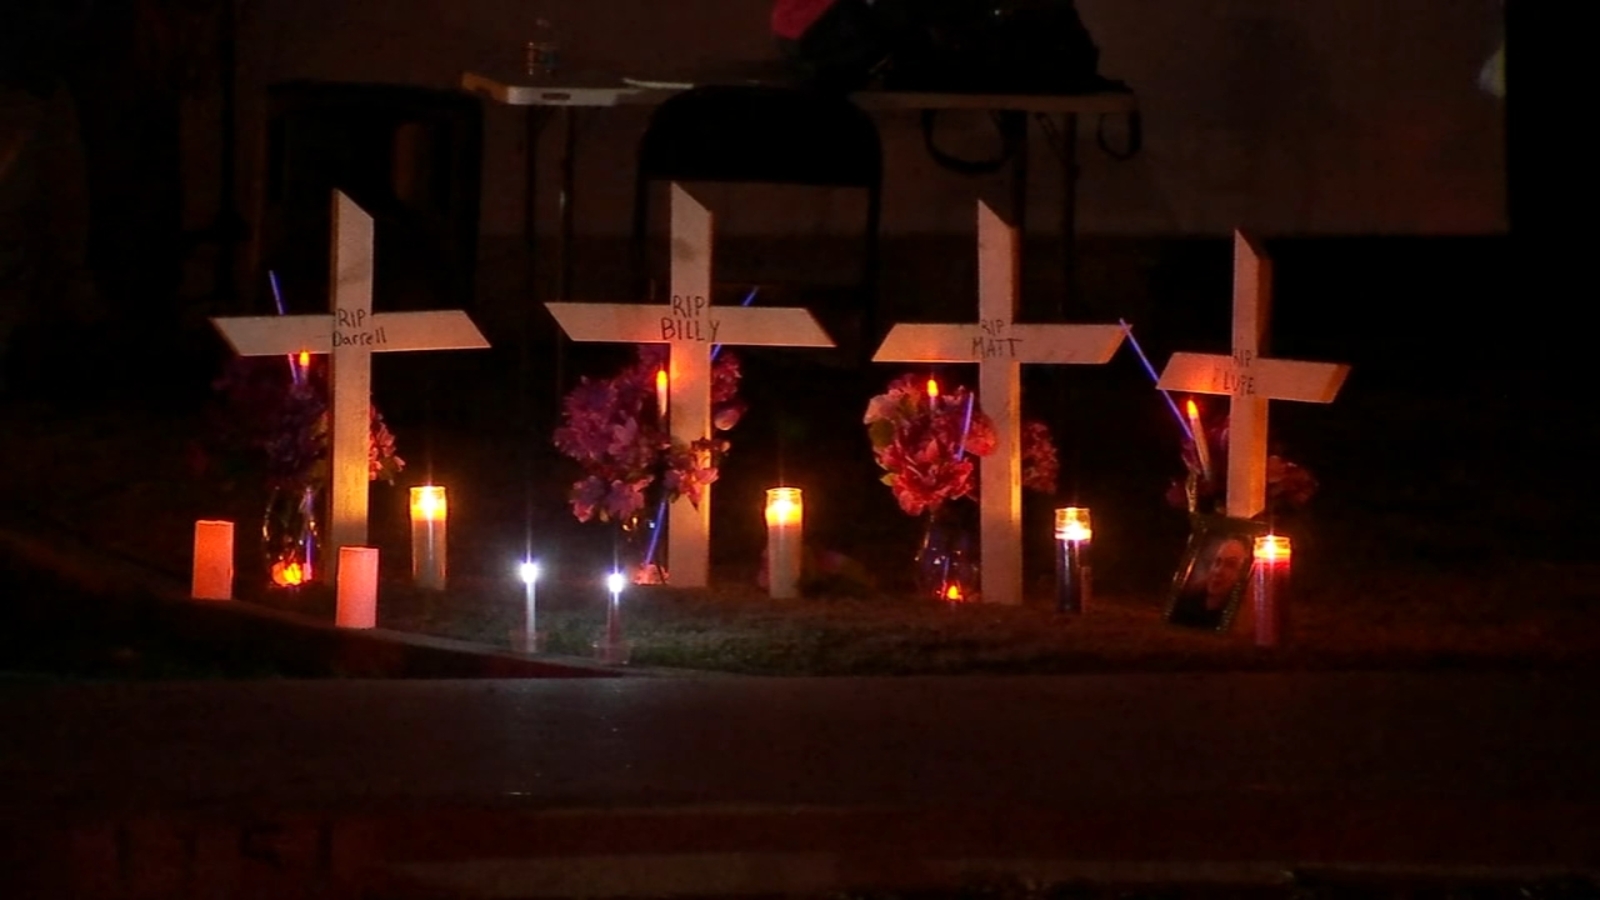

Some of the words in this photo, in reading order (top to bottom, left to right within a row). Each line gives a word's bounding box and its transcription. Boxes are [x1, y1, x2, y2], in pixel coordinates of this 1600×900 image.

[673, 294, 705, 318] RIP
[337, 308, 366, 328] RIP
[660, 316, 720, 342] BILLY
[332, 326, 387, 347] Darrell
[972, 336, 1023, 359] MATT
